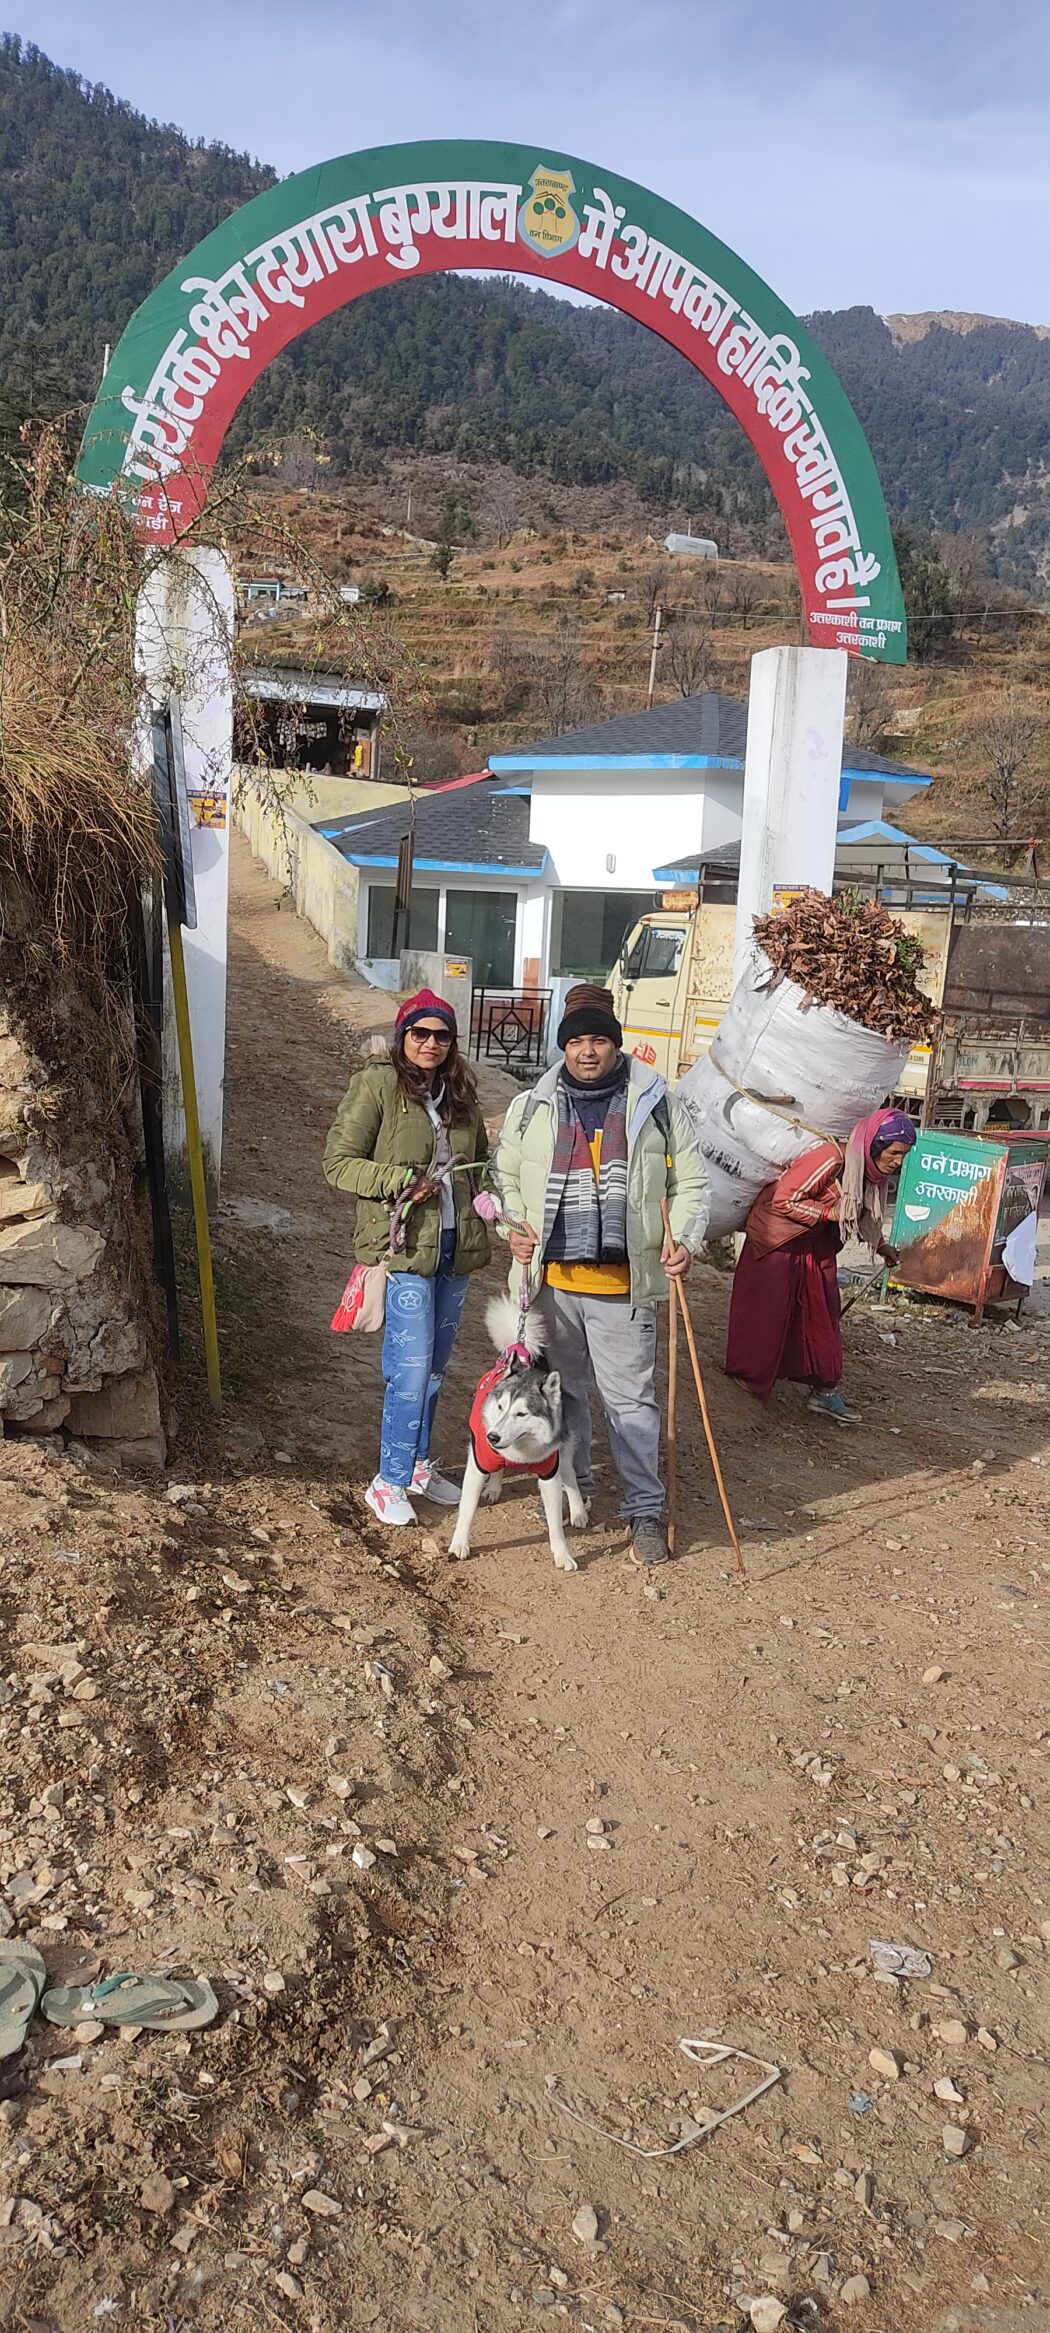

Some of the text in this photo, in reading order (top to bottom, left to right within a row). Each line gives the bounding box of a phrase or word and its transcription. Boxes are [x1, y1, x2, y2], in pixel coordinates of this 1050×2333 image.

[121, 328, 221, 483] पर्यटक
[180, 260, 270, 360] क्षेत्र
[243, 194, 379, 309] दयारा
[373, 182, 523, 270] बुग्याल
[578, 188, 626, 270] में
[611, 225, 742, 347] आपका
[717, 309, 811, 432] हार्दिक
[783, 410, 861, 560] स्वागत
[810, 611, 903, 633] उत्तरकाशी वन प्रभाग
[836, 631, 887, 649] उत्तरकाशी
[948, 1158, 994, 1183] प्रभाग
[914, 1181, 979, 1208] उत्तरकाशी
